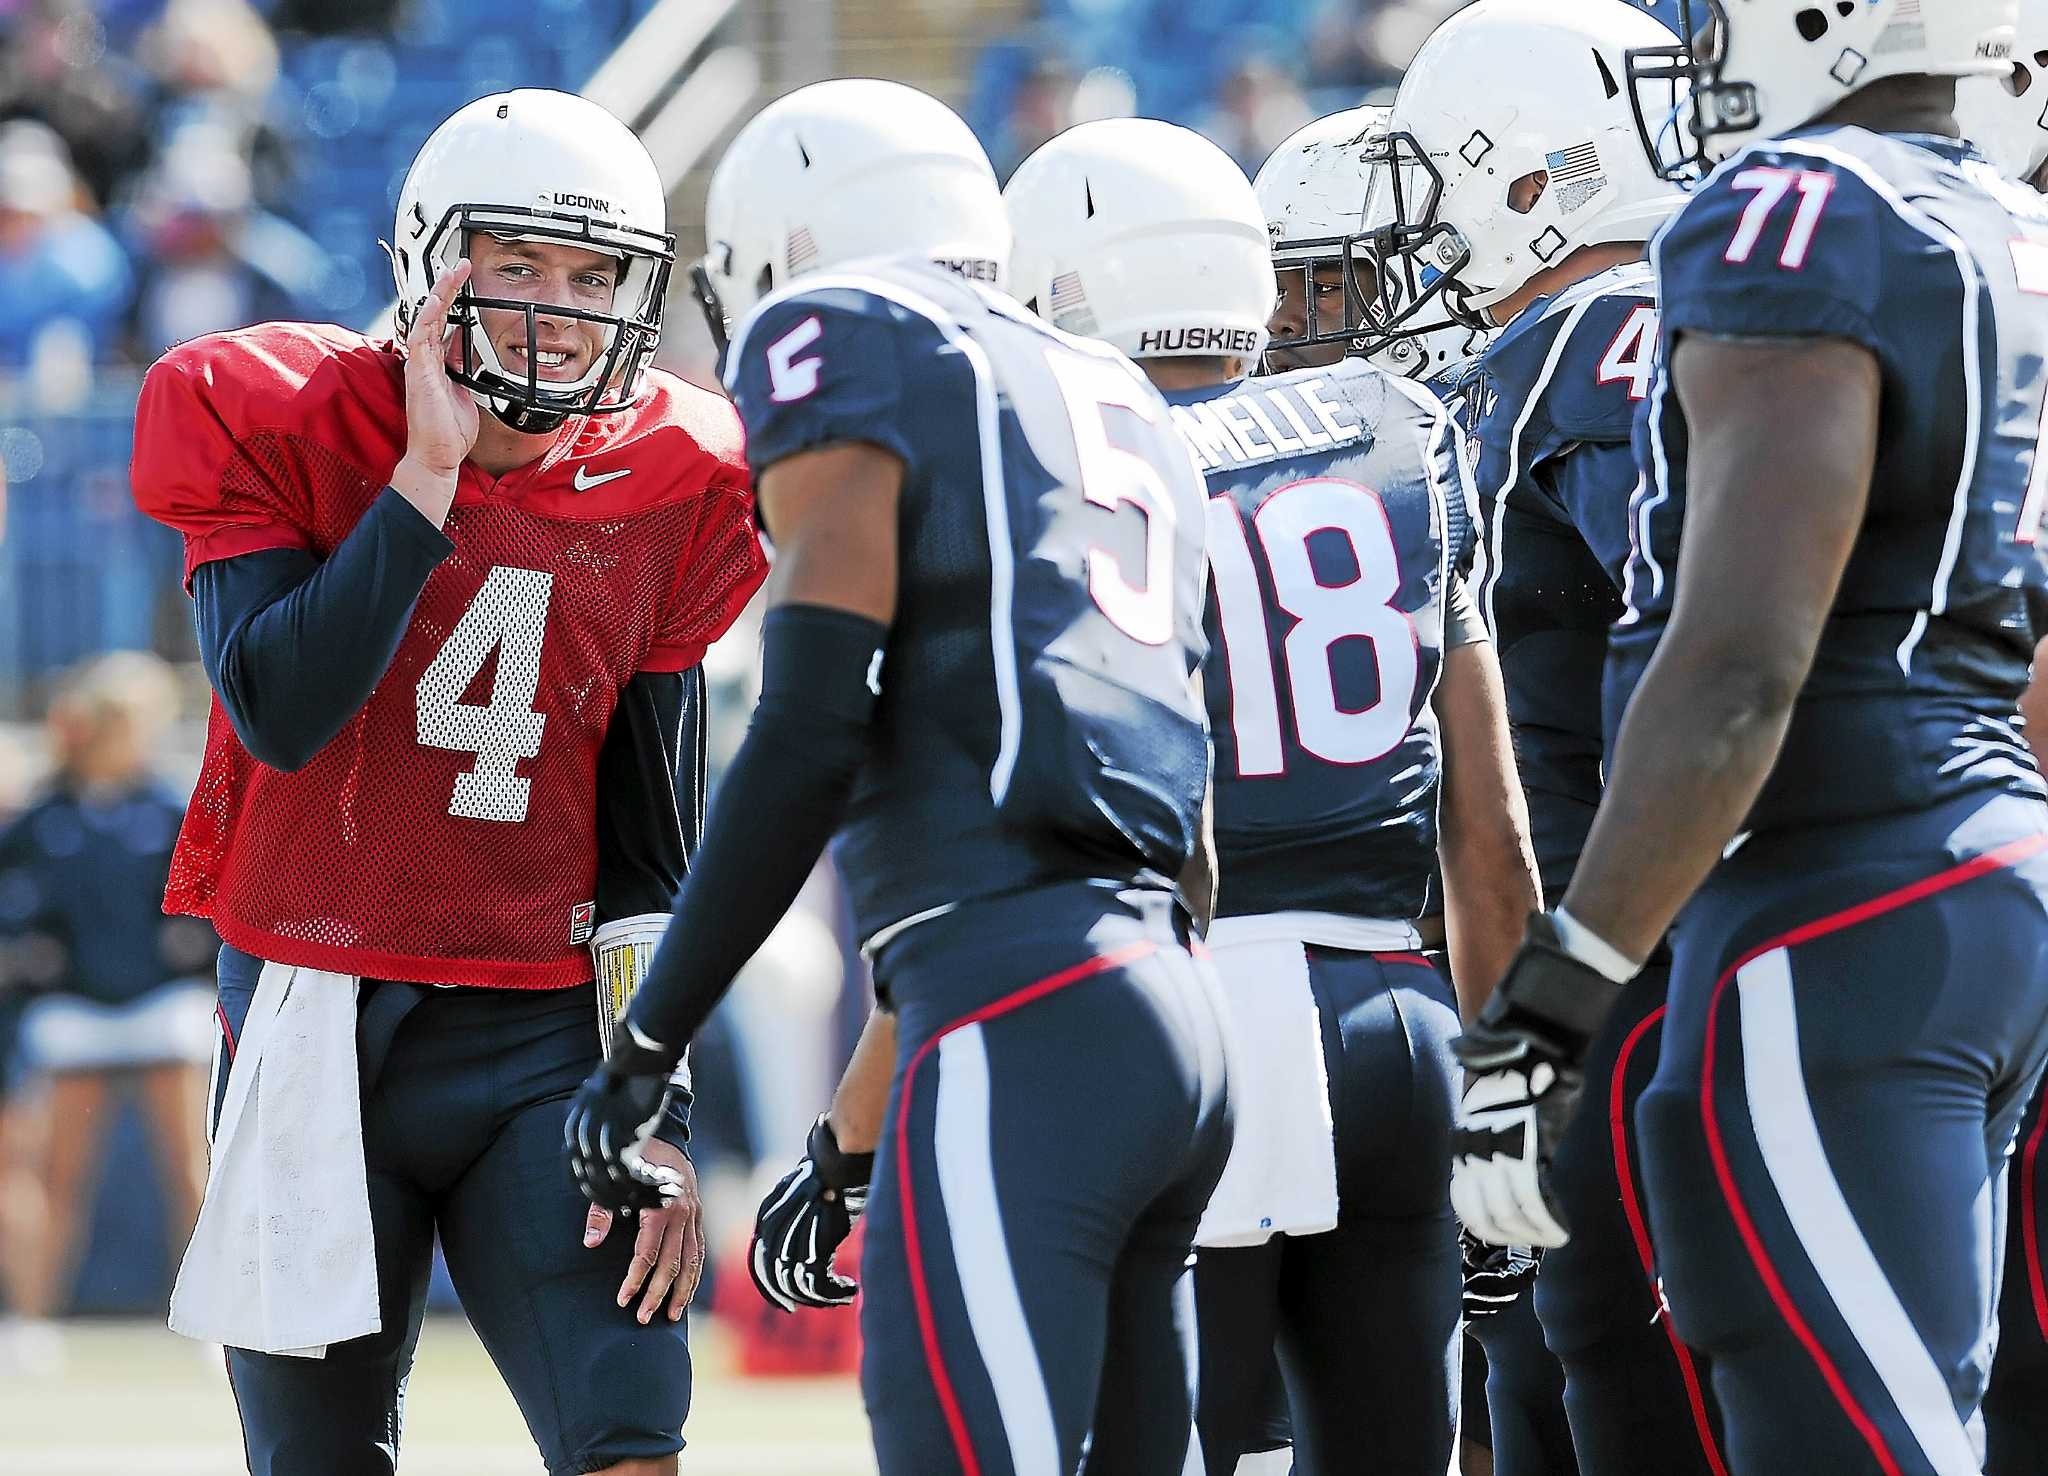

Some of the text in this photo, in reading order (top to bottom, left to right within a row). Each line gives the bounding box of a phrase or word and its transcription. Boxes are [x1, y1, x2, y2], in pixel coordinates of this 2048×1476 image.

[553, 192, 609, 213] UCONN
[1723, 165, 1836, 272] 71
[1140, 327, 1258, 351] HUSKIES
[1595, 303, 1662, 401] 4
[1168, 377, 1363, 470] MELLE
[1043, 351, 1178, 645] 5
[1206, 476, 1420, 778] 18
[415, 564, 554, 823] 4
